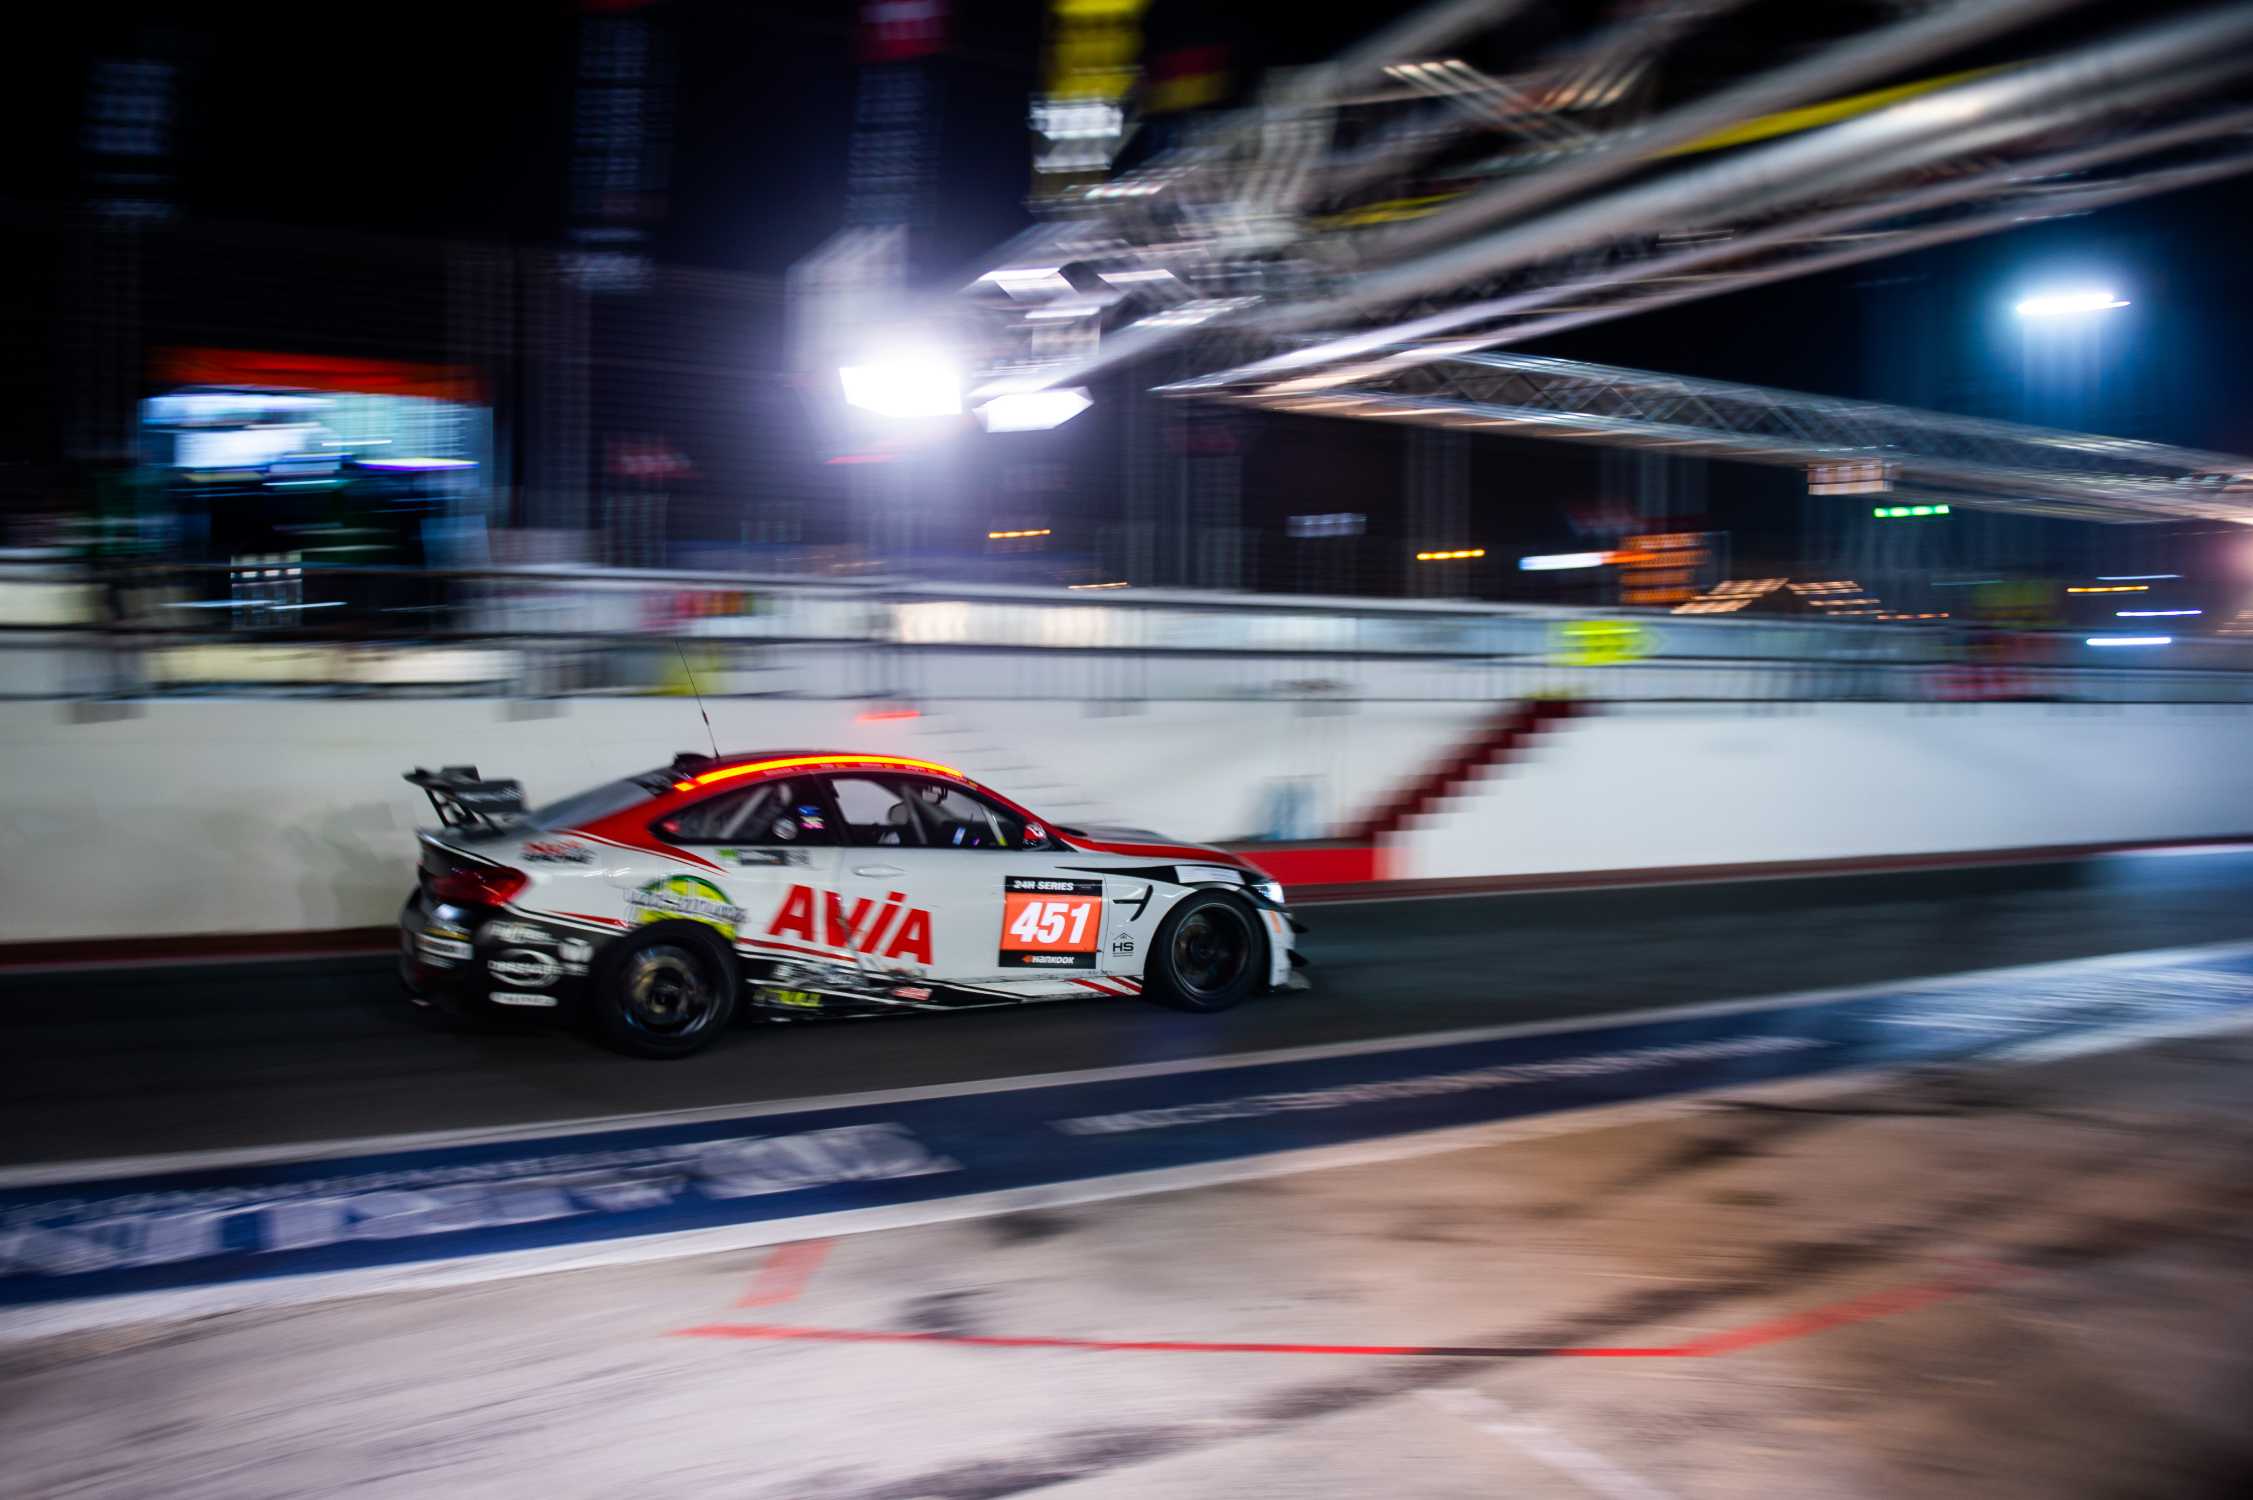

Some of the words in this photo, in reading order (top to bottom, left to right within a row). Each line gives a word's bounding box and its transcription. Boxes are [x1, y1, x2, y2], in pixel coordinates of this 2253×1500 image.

[1014, 881, 1035, 889] 24H
[1037, 881, 1074, 891] SERIES
[1010, 902, 1091, 944] 451
[1112, 942, 1135, 952] HS
